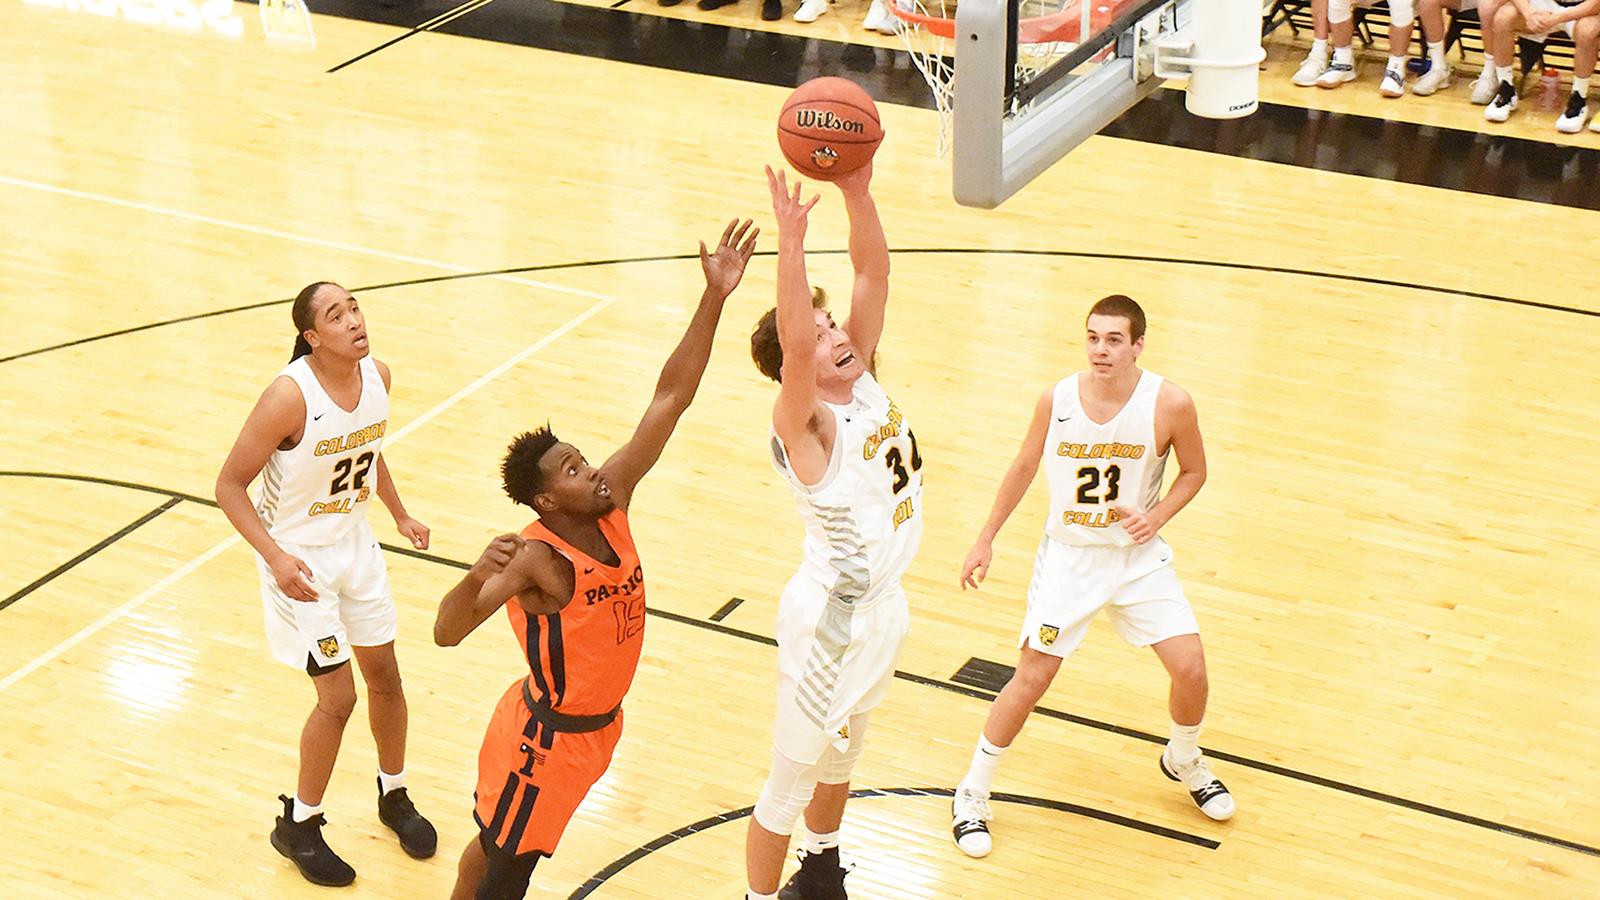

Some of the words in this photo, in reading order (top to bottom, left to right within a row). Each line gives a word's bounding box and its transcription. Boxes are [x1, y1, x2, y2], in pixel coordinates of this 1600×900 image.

[796, 109, 865, 134] Wilson
[314, 420, 387, 456] COLORADO
[1057, 442, 1145, 459] COLORADO
[329, 451, 374, 496] 22
[1076, 464, 1120, 504] 23
